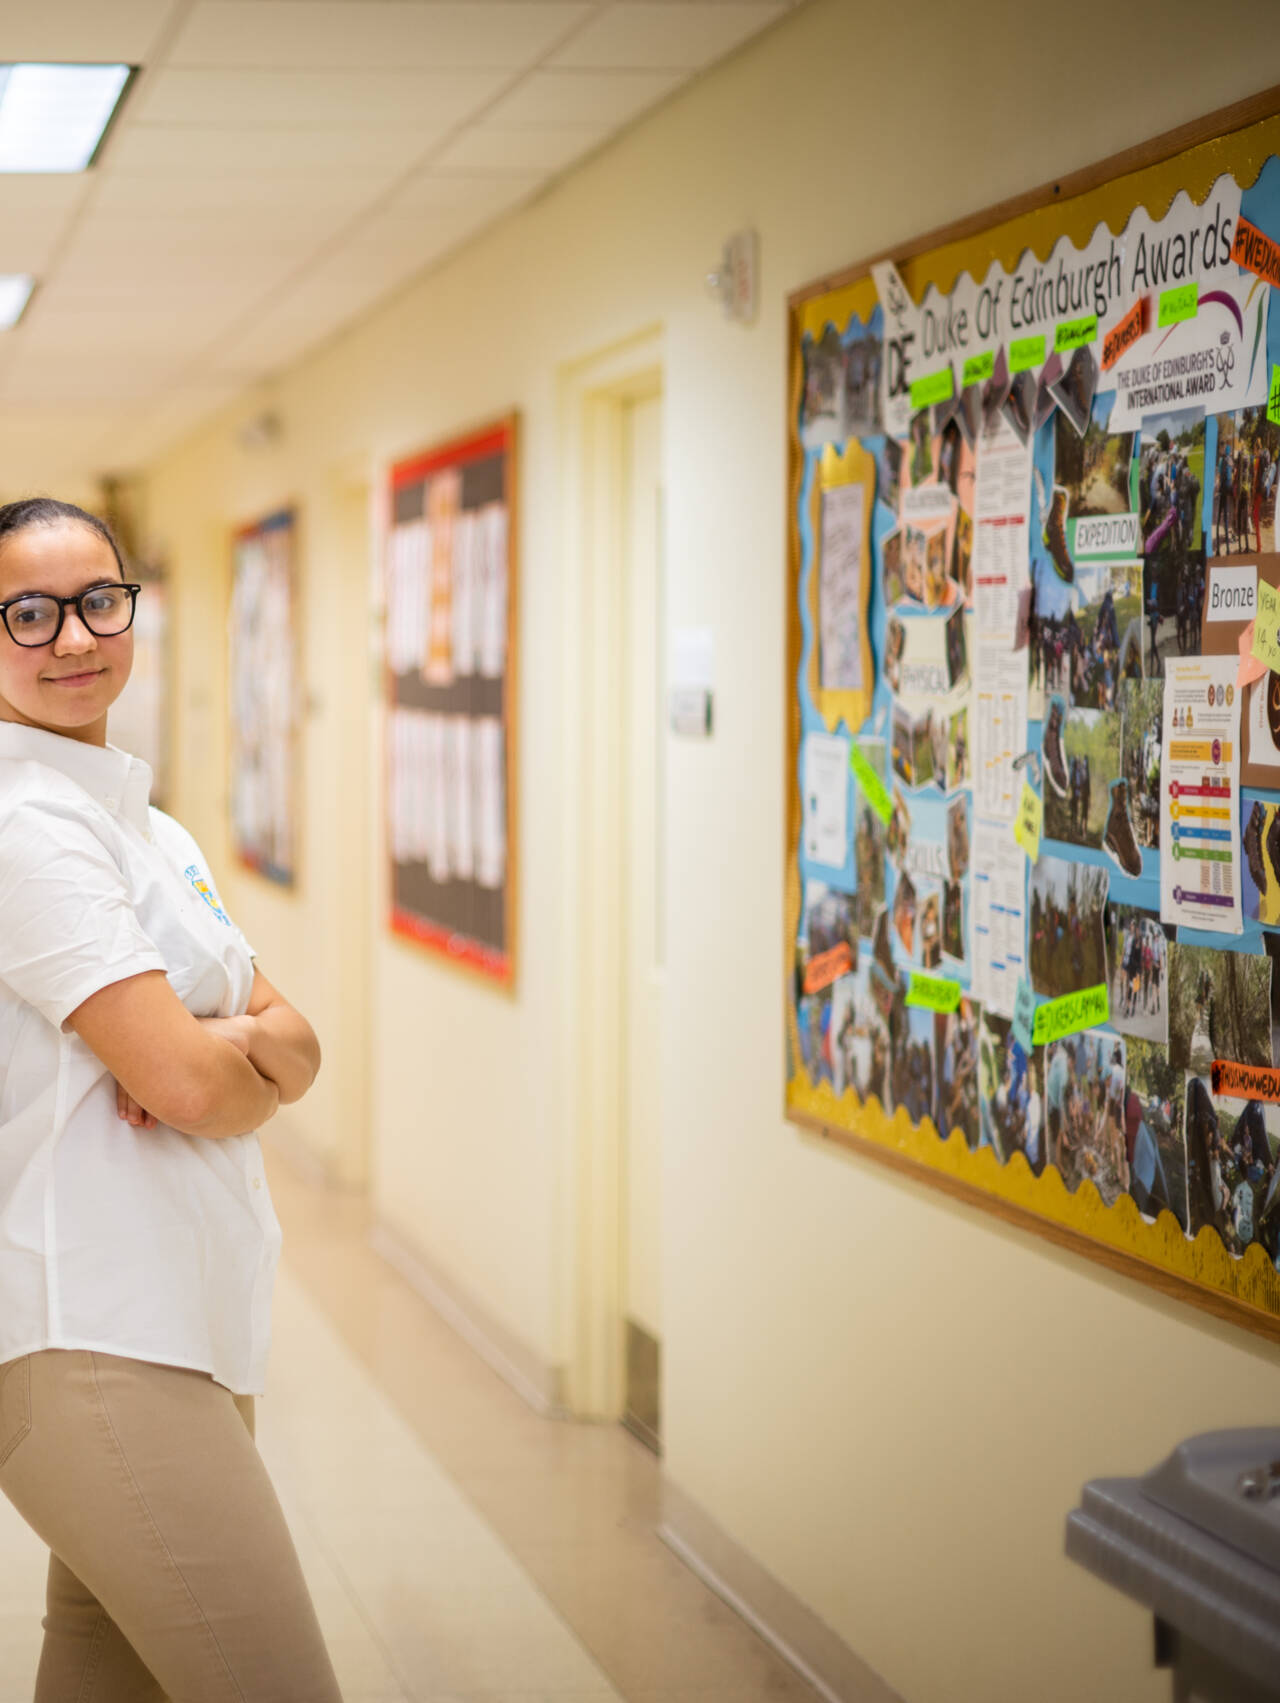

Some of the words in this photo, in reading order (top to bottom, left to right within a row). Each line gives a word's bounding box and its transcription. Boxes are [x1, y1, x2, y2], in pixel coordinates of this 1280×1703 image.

[922, 297, 968, 358] Duke
[976, 280, 1003, 339] Of
[1010, 239, 1121, 330] Edinburgh
[1132, 202, 1232, 291] Awards
[1118, 370, 1131, 389] THE
[1132, 363, 1151, 385] DUKE
[1152, 359, 1162, 381] OF
[1163, 348, 1215, 378] EDINBURGH'S
[1127, 379, 1184, 410] INTERNATIONAL
[1185, 373, 1215, 397] AWARD
[1078, 519, 1136, 548] EXPEDITION
[1212, 583, 1254, 608] Bronze
